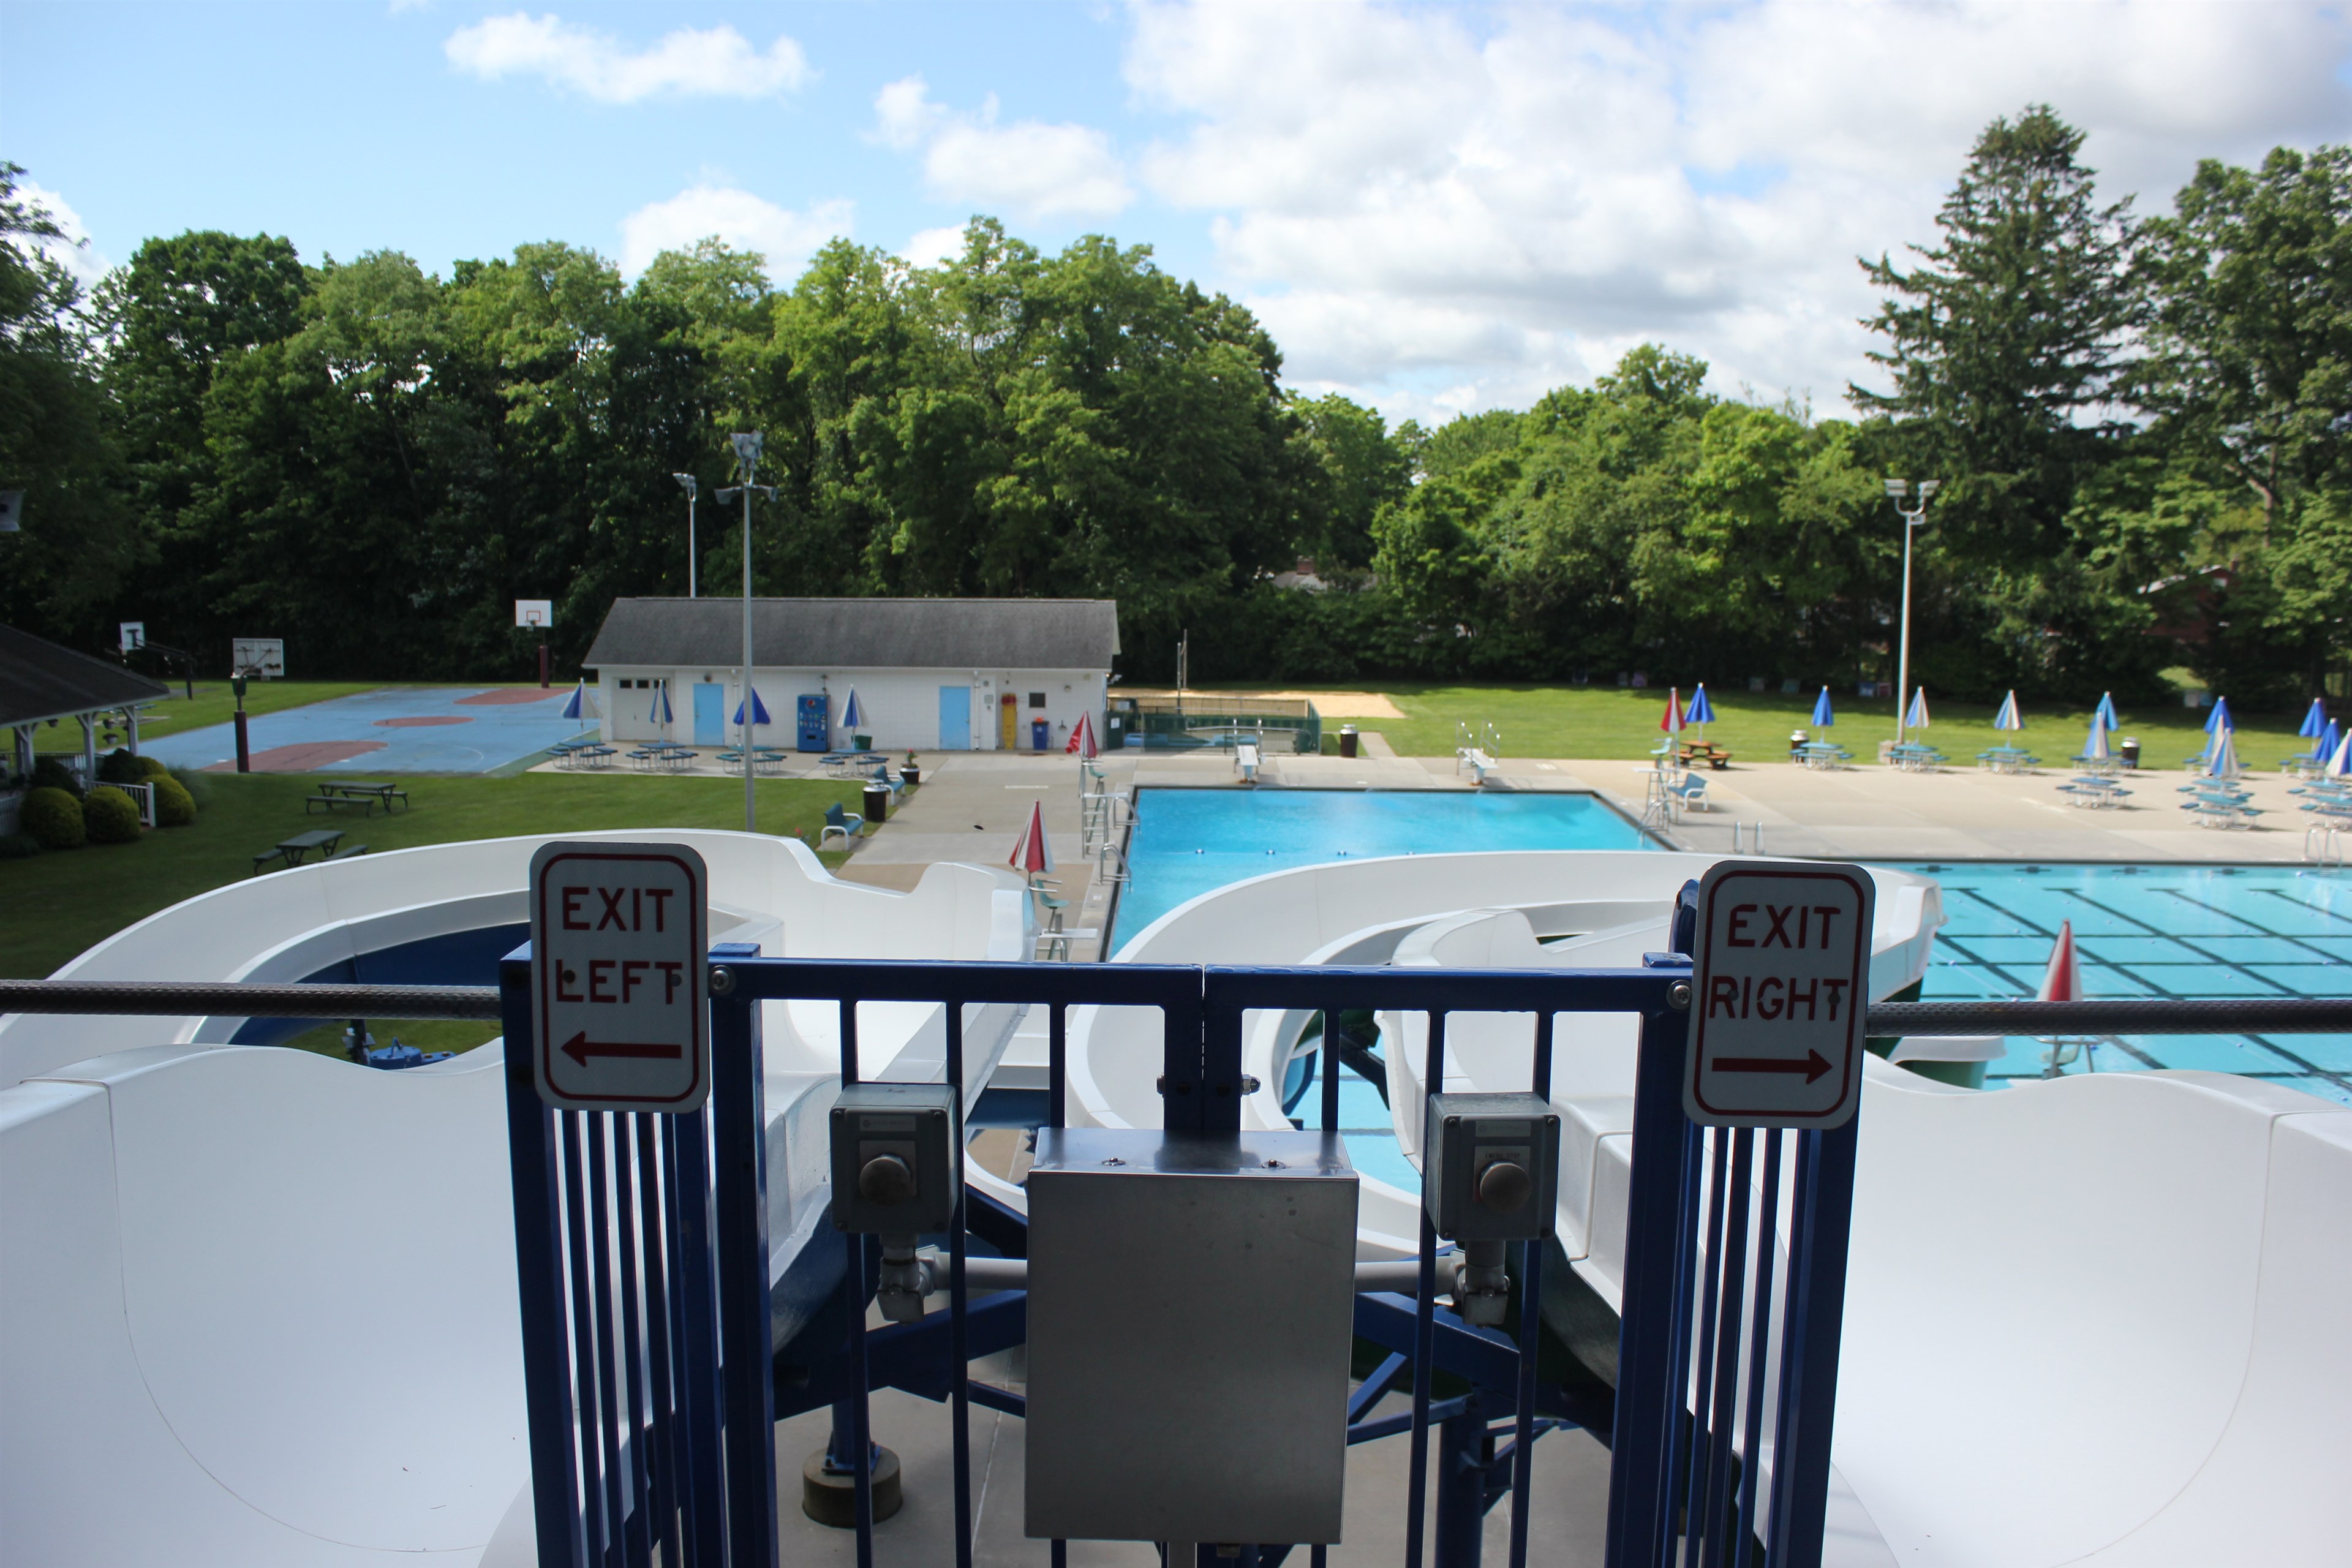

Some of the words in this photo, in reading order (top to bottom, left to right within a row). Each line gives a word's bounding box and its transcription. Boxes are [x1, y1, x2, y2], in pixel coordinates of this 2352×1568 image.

[562, 887, 673, 932] EXIT
[1727, 904, 1841, 949] EXIT
[556, 959, 682, 1005] LEFT
[1709, 976, 1849, 1021] RIGHT
